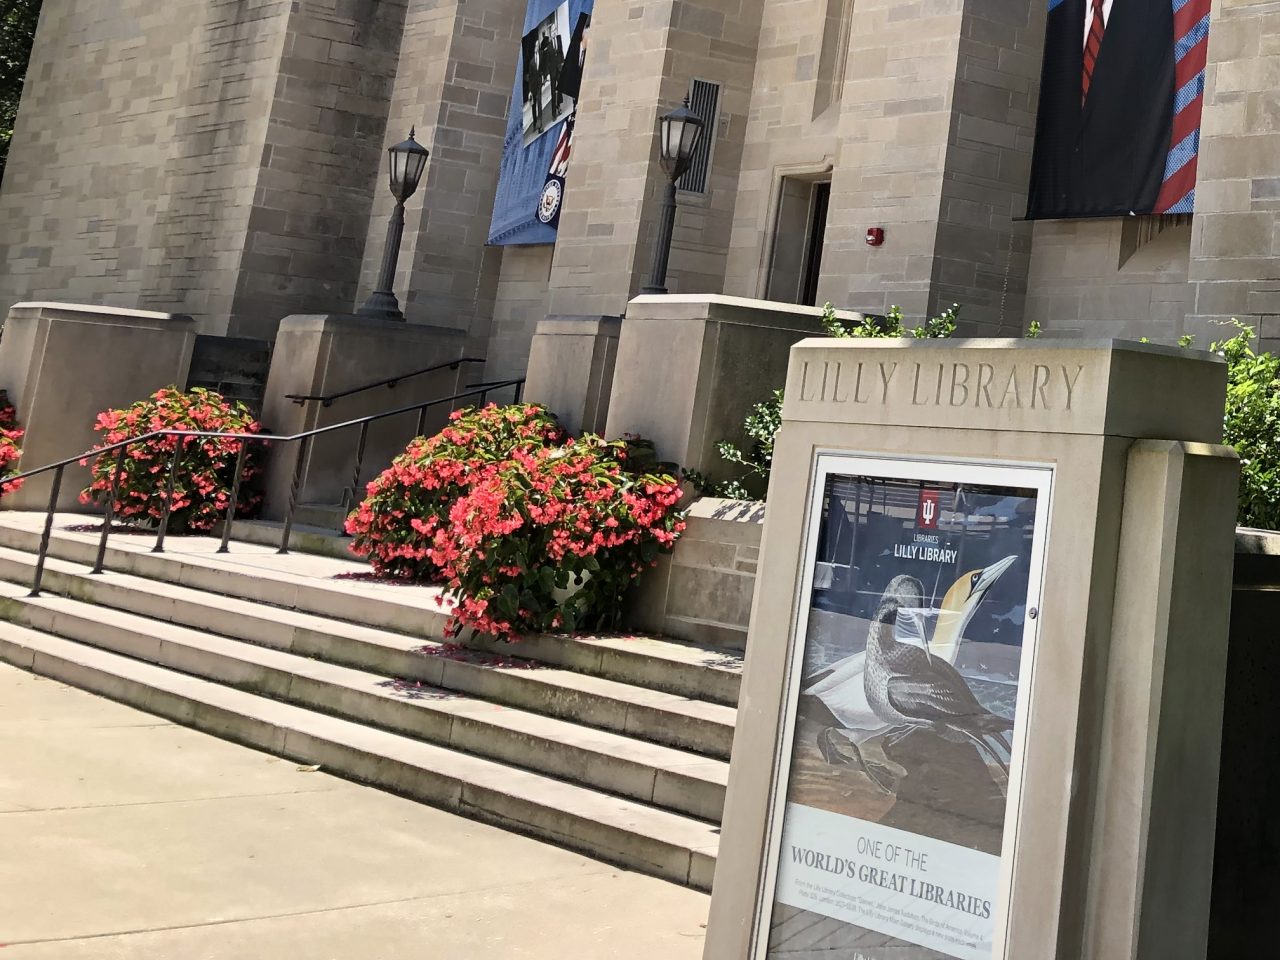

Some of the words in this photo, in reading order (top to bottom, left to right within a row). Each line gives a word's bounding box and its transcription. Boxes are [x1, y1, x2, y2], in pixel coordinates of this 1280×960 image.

[799, 361, 898, 405] LILLY
[911, 361, 1085, 411] LIBRARY
[894, 543, 918, 559] LILLY
[918, 546, 958, 564] LIBRARY
[913, 533, 939, 544] LIBRARIES
[856, 836, 883, 859] ONE
[884, 843, 900, 864] OF
[904, 848, 929, 872] THE
[791, 845, 856, 879] WORLD'S
[858, 864, 908, 893] GREAT
[909, 878, 992, 920] LIBRARIES
